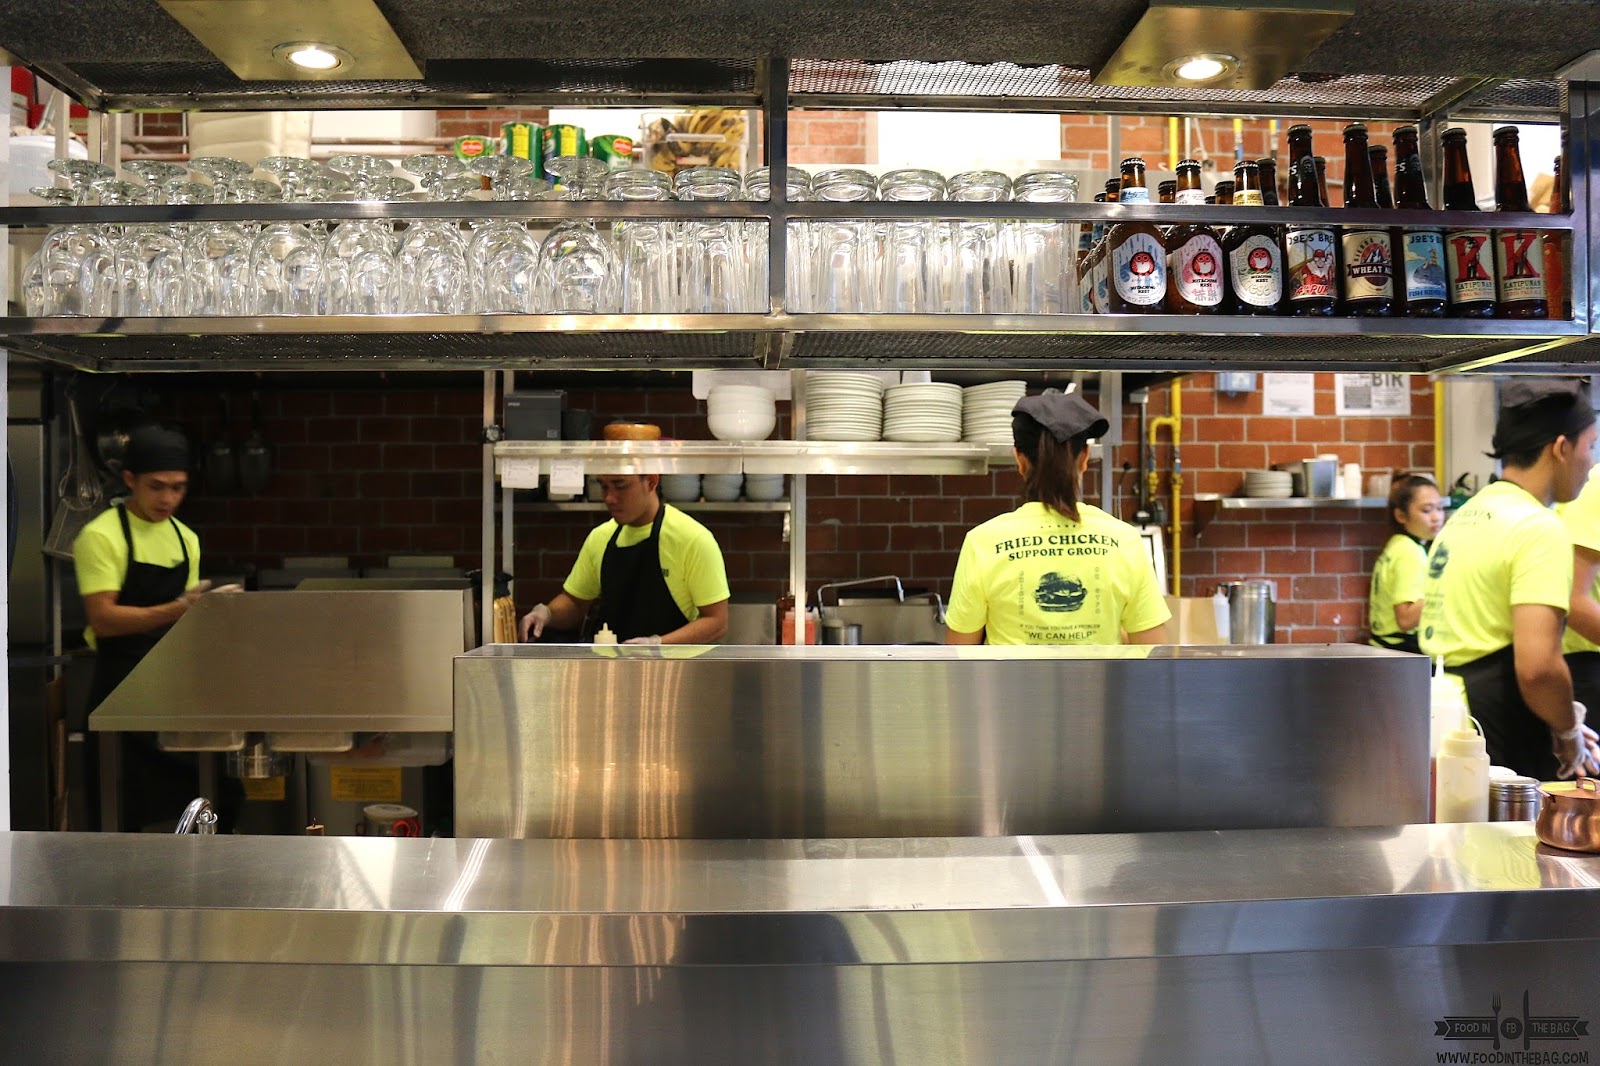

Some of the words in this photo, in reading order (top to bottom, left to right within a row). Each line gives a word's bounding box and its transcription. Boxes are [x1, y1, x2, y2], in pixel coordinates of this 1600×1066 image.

[1352, 266, 1382, 275] WHEAT
[995, 536, 1043, 554] FRIED
[1048, 534, 1119, 548] CHICKEN
[1008, 548, 1064, 561] SUPPORT
[1067, 547, 1109, 556] GROUP
